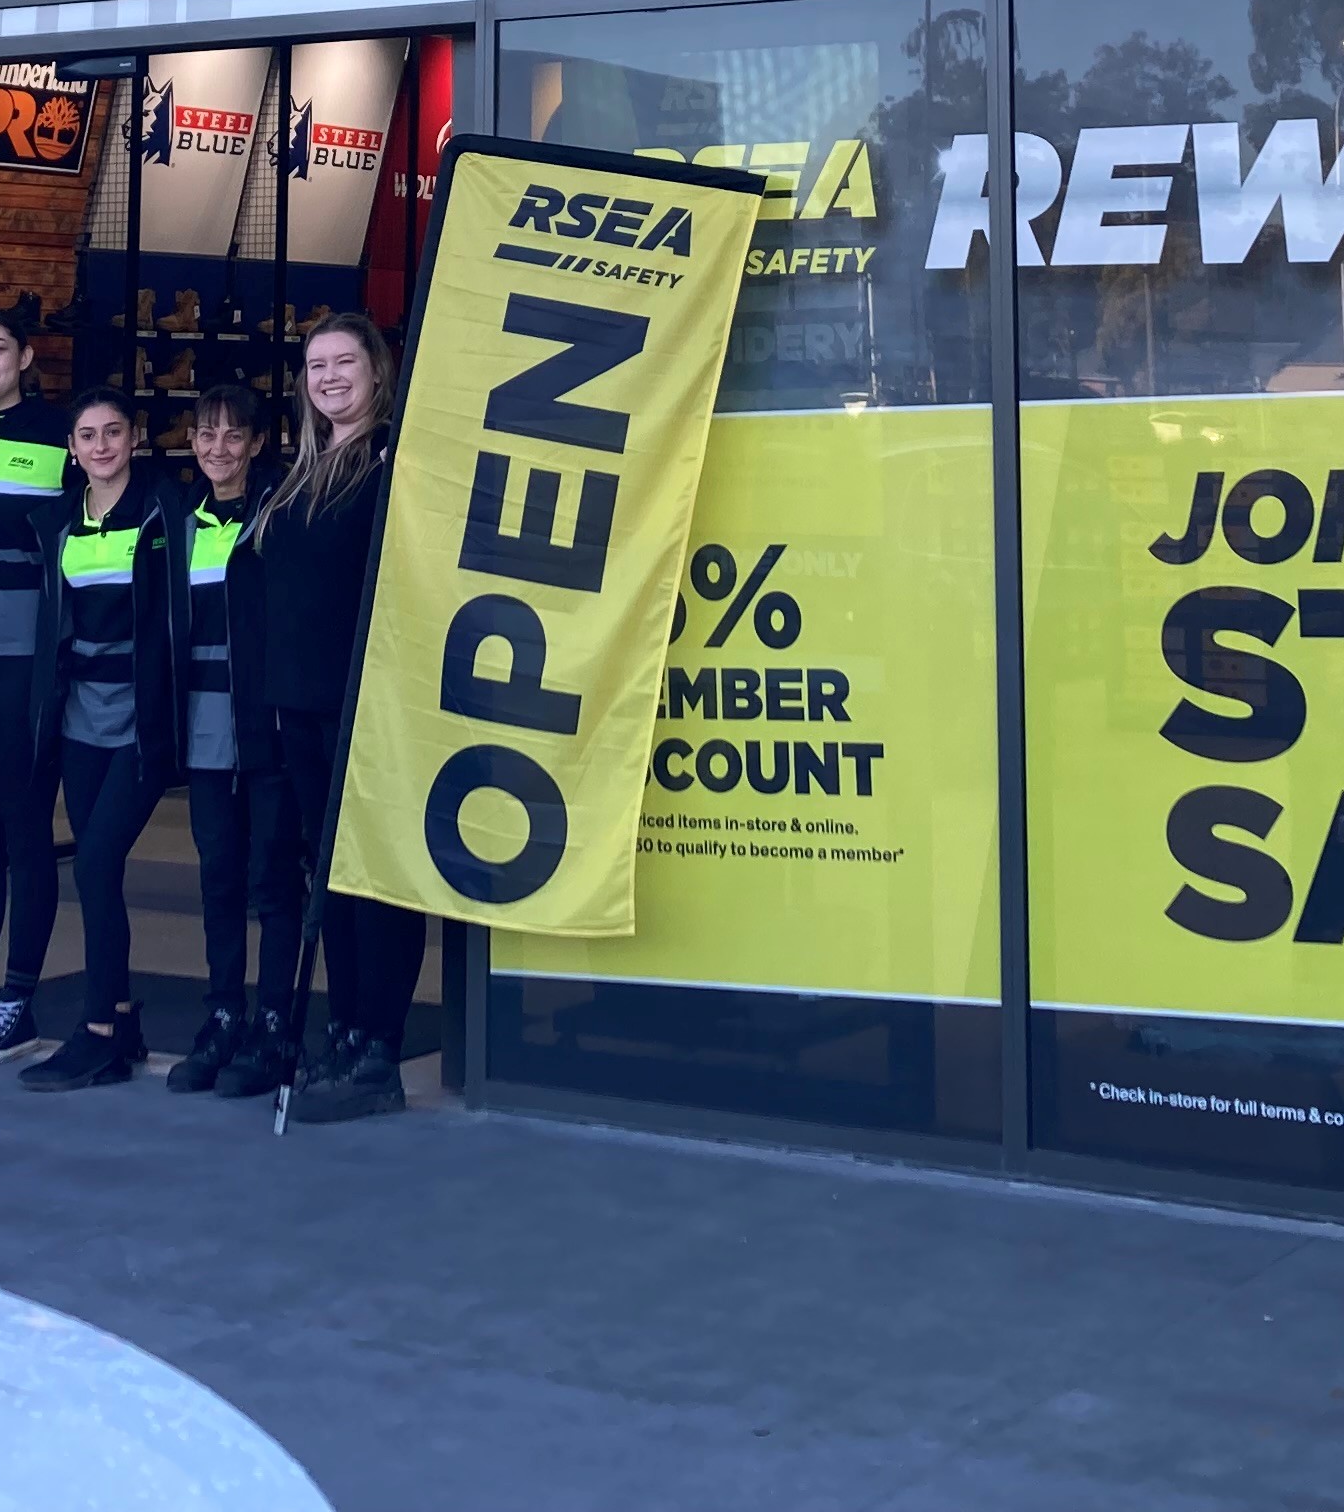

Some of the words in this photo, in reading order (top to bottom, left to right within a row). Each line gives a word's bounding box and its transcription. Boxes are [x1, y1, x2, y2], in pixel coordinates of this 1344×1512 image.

[181, 109, 251, 135] STEEL
[176, 131, 246, 156] BLUE
[318, 127, 380, 150] STEEL
[313, 148, 377, 171] BLUE
[508, 184, 693, 258] RSEA
[745, 246, 877, 275] SAFETY
[592, 261, 685, 290] SAFETY
[424, 292, 651, 905] OPEN
[657, 667, 852, 722] MBER
[645, 738, 885, 797] COUNT
[678, 813, 721, 829] items
[725, 816, 787, 832] in-store
[790, 817, 802, 833] &
[657, 839, 672, 853] to
[676, 840, 727, 859] qualify
[731, 842, 746, 856] to
[750, 841, 814, 859] become
[818, 847, 826, 860] a
[1149, 1088, 1207, 1111] in-store
[1210, 1095, 1232, 1114] for
[1234, 1098, 1257, 1117] full
[1260, 1102, 1306, 1122] terms
[1309, 1107, 1322, 1124] &
